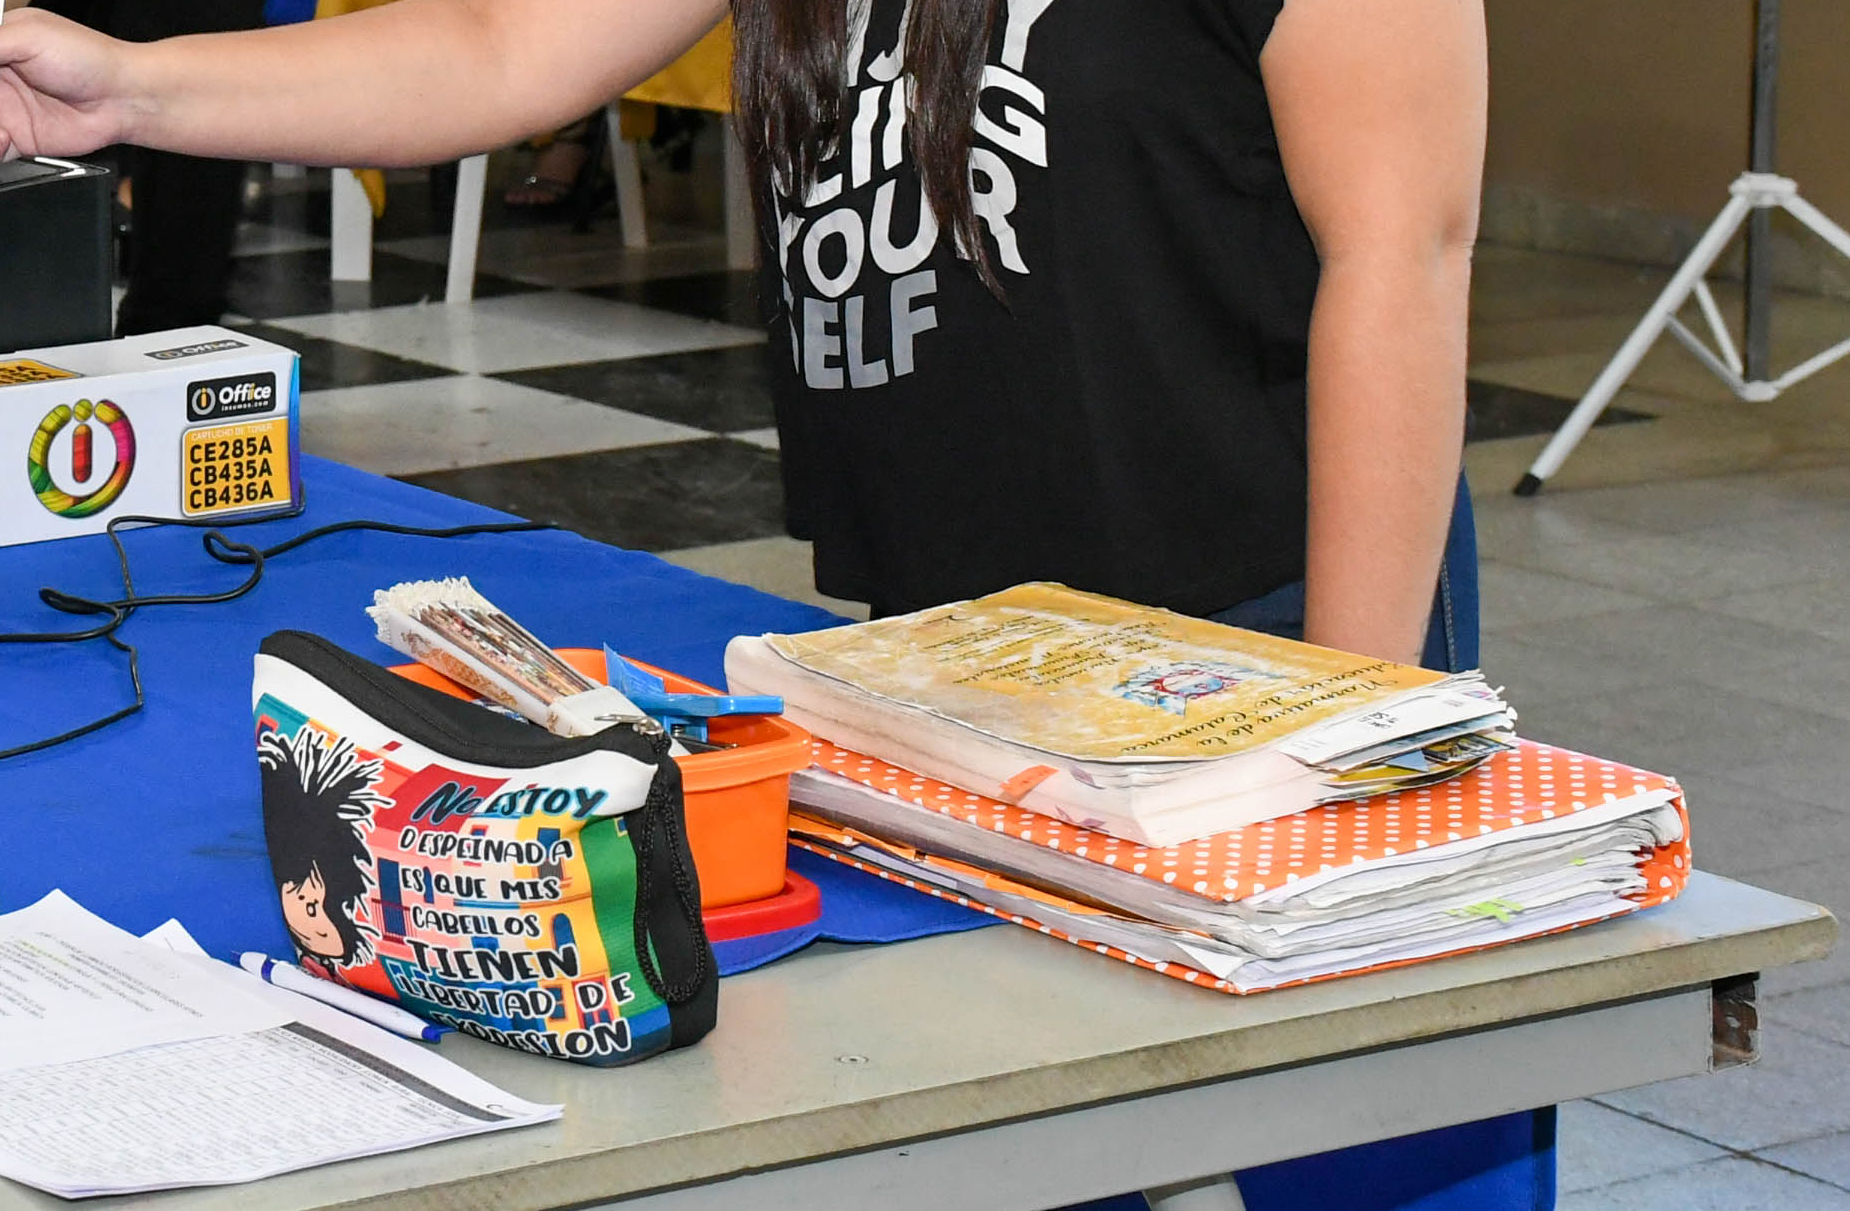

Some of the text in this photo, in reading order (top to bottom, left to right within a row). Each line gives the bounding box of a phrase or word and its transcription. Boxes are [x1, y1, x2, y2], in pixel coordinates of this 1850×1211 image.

[783, 269, 938, 388] ELF
[218, 383, 272, 404] Office
[190, 435, 273, 464] CE285A
[190, 458, 273, 486] CB435A
[190, 480, 274, 510] CB436A
[1256, 680, 1398, 725] Normativa
[1197, 735, 1227, 747] la
[1227, 723, 1254, 738] de
[485, 787, 607, 819] ESTOY
[399, 827, 573, 863] DESPEINADA
[402, 867, 561, 900] ES QUE MIS
[412, 906, 541, 937] CABELLOS
[406, 940, 579, 983] TIENEN
[399, 972, 634, 1017] LIBERTAD DE
